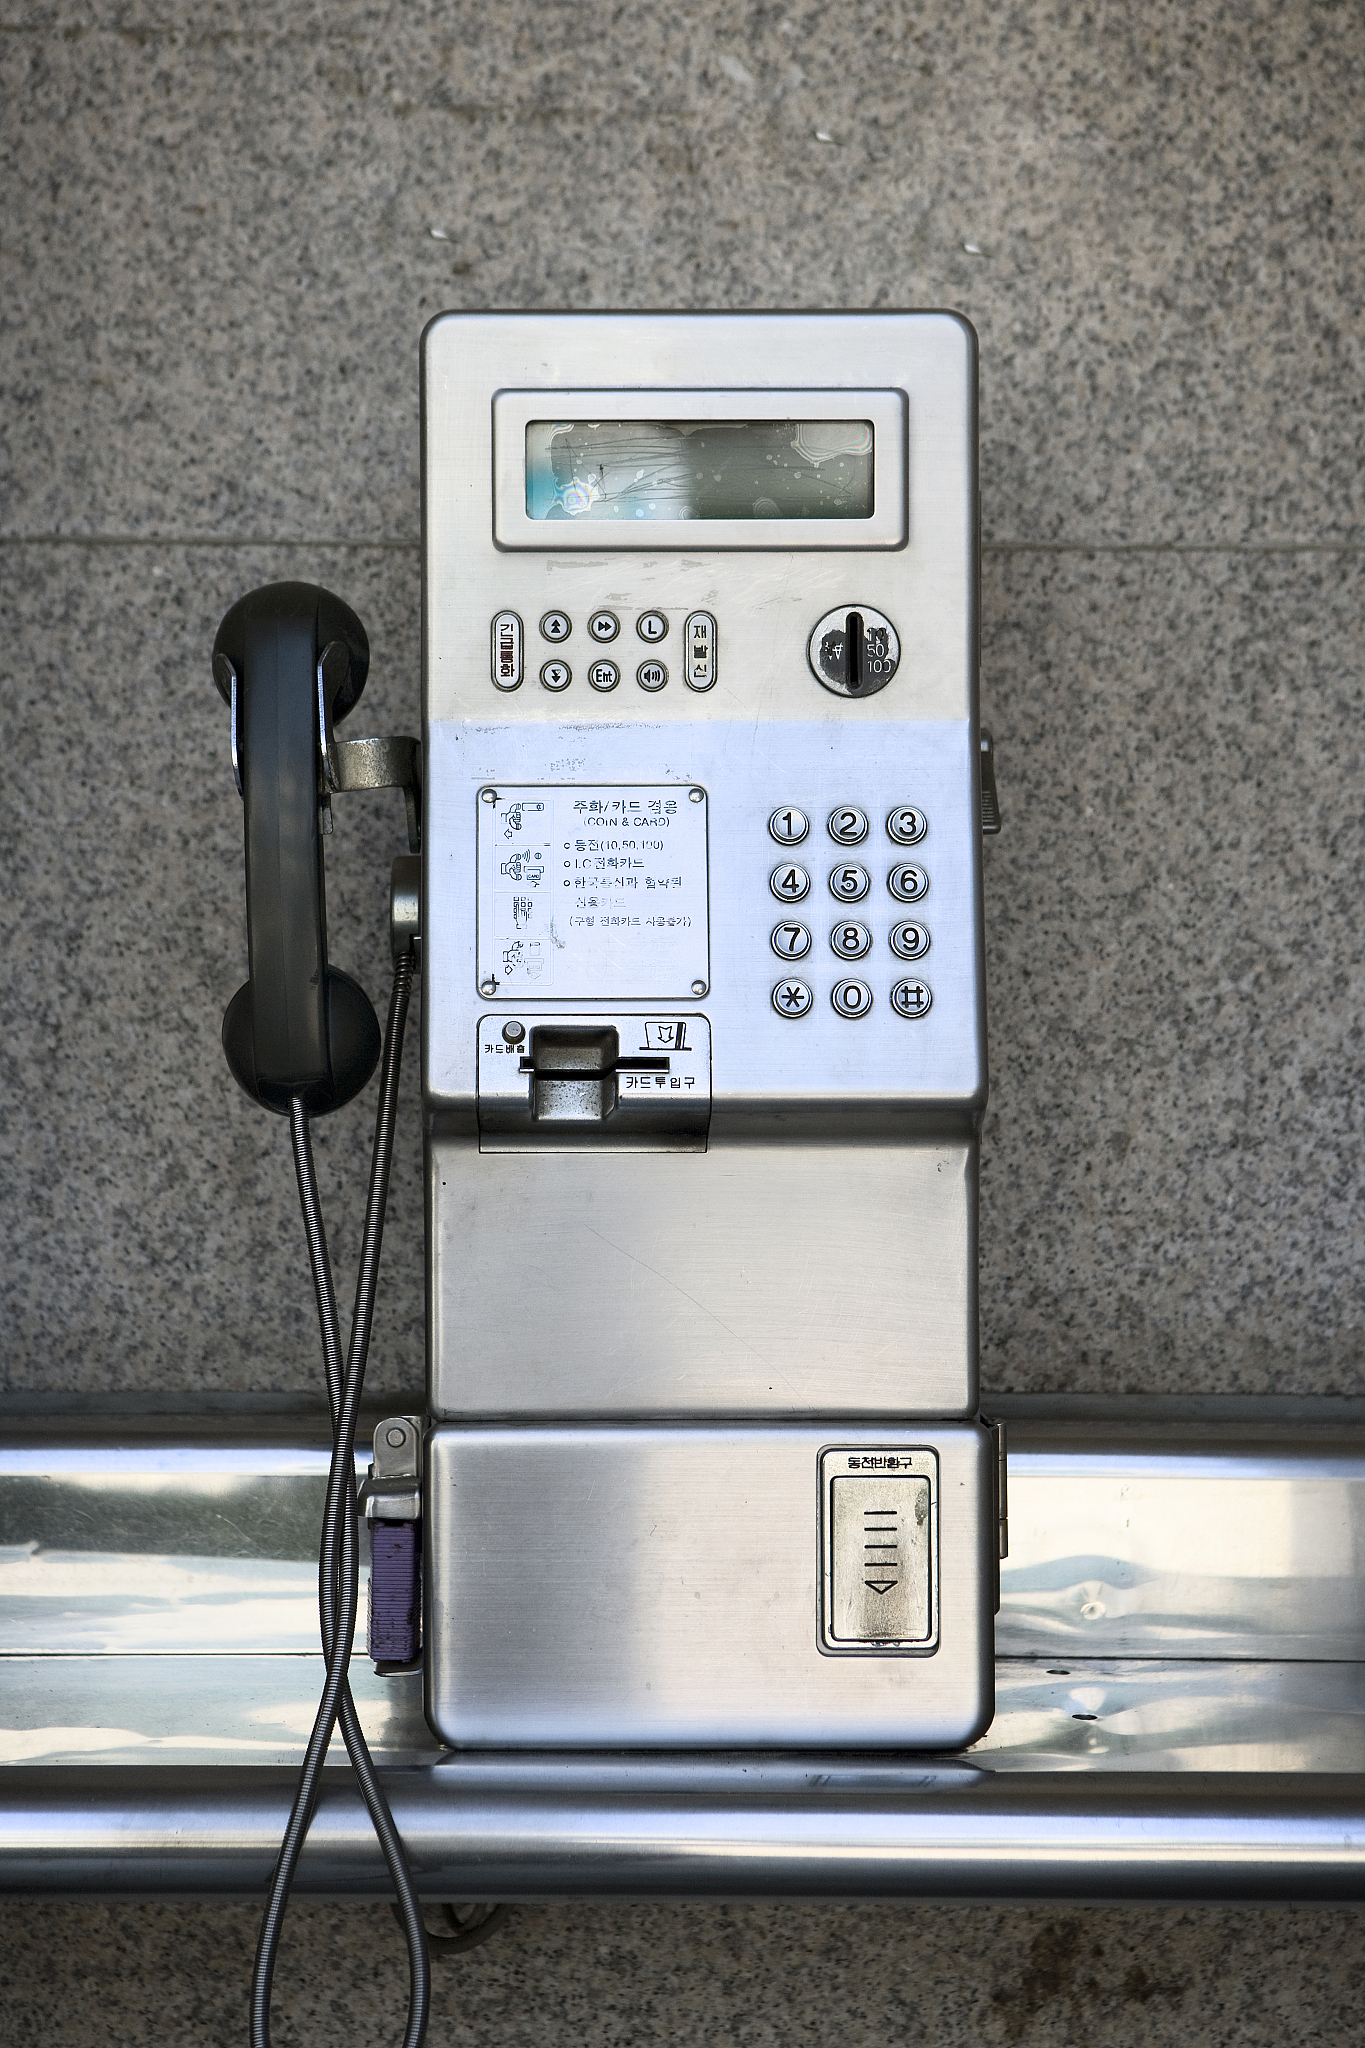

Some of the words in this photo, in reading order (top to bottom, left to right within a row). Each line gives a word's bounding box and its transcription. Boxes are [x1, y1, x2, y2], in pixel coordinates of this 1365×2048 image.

[648, 620, 658, 635] L
[500, 623, 515, 678] 긴급통화
[693, 625, 709, 678] 재발신
[866, 643, 885, 658] 50
[867, 659, 892, 673] 100
[595, 668, 613, 684] Ent
[573, 799, 643, 815] 주화/카드
[621, 817, 630, 827] &
[633, 816, 670, 828] CARD)
[782, 812, 792, 836] 1
[839, 812, 857, 835] 2
[899, 812, 917, 835] 3
[781, 869, 799, 893] 4
[841, 869, 858, 893] 5
[901, 869, 918, 893] 6
[783, 927, 801, 951] 7
[842, 927, 860, 950] 8
[901, 927, 920, 951] 9
[843, 985, 861, 1009] 0
[484, 1044, 526, 1054] 카드배출
[625, 1076, 696, 1089] 카드투입구
